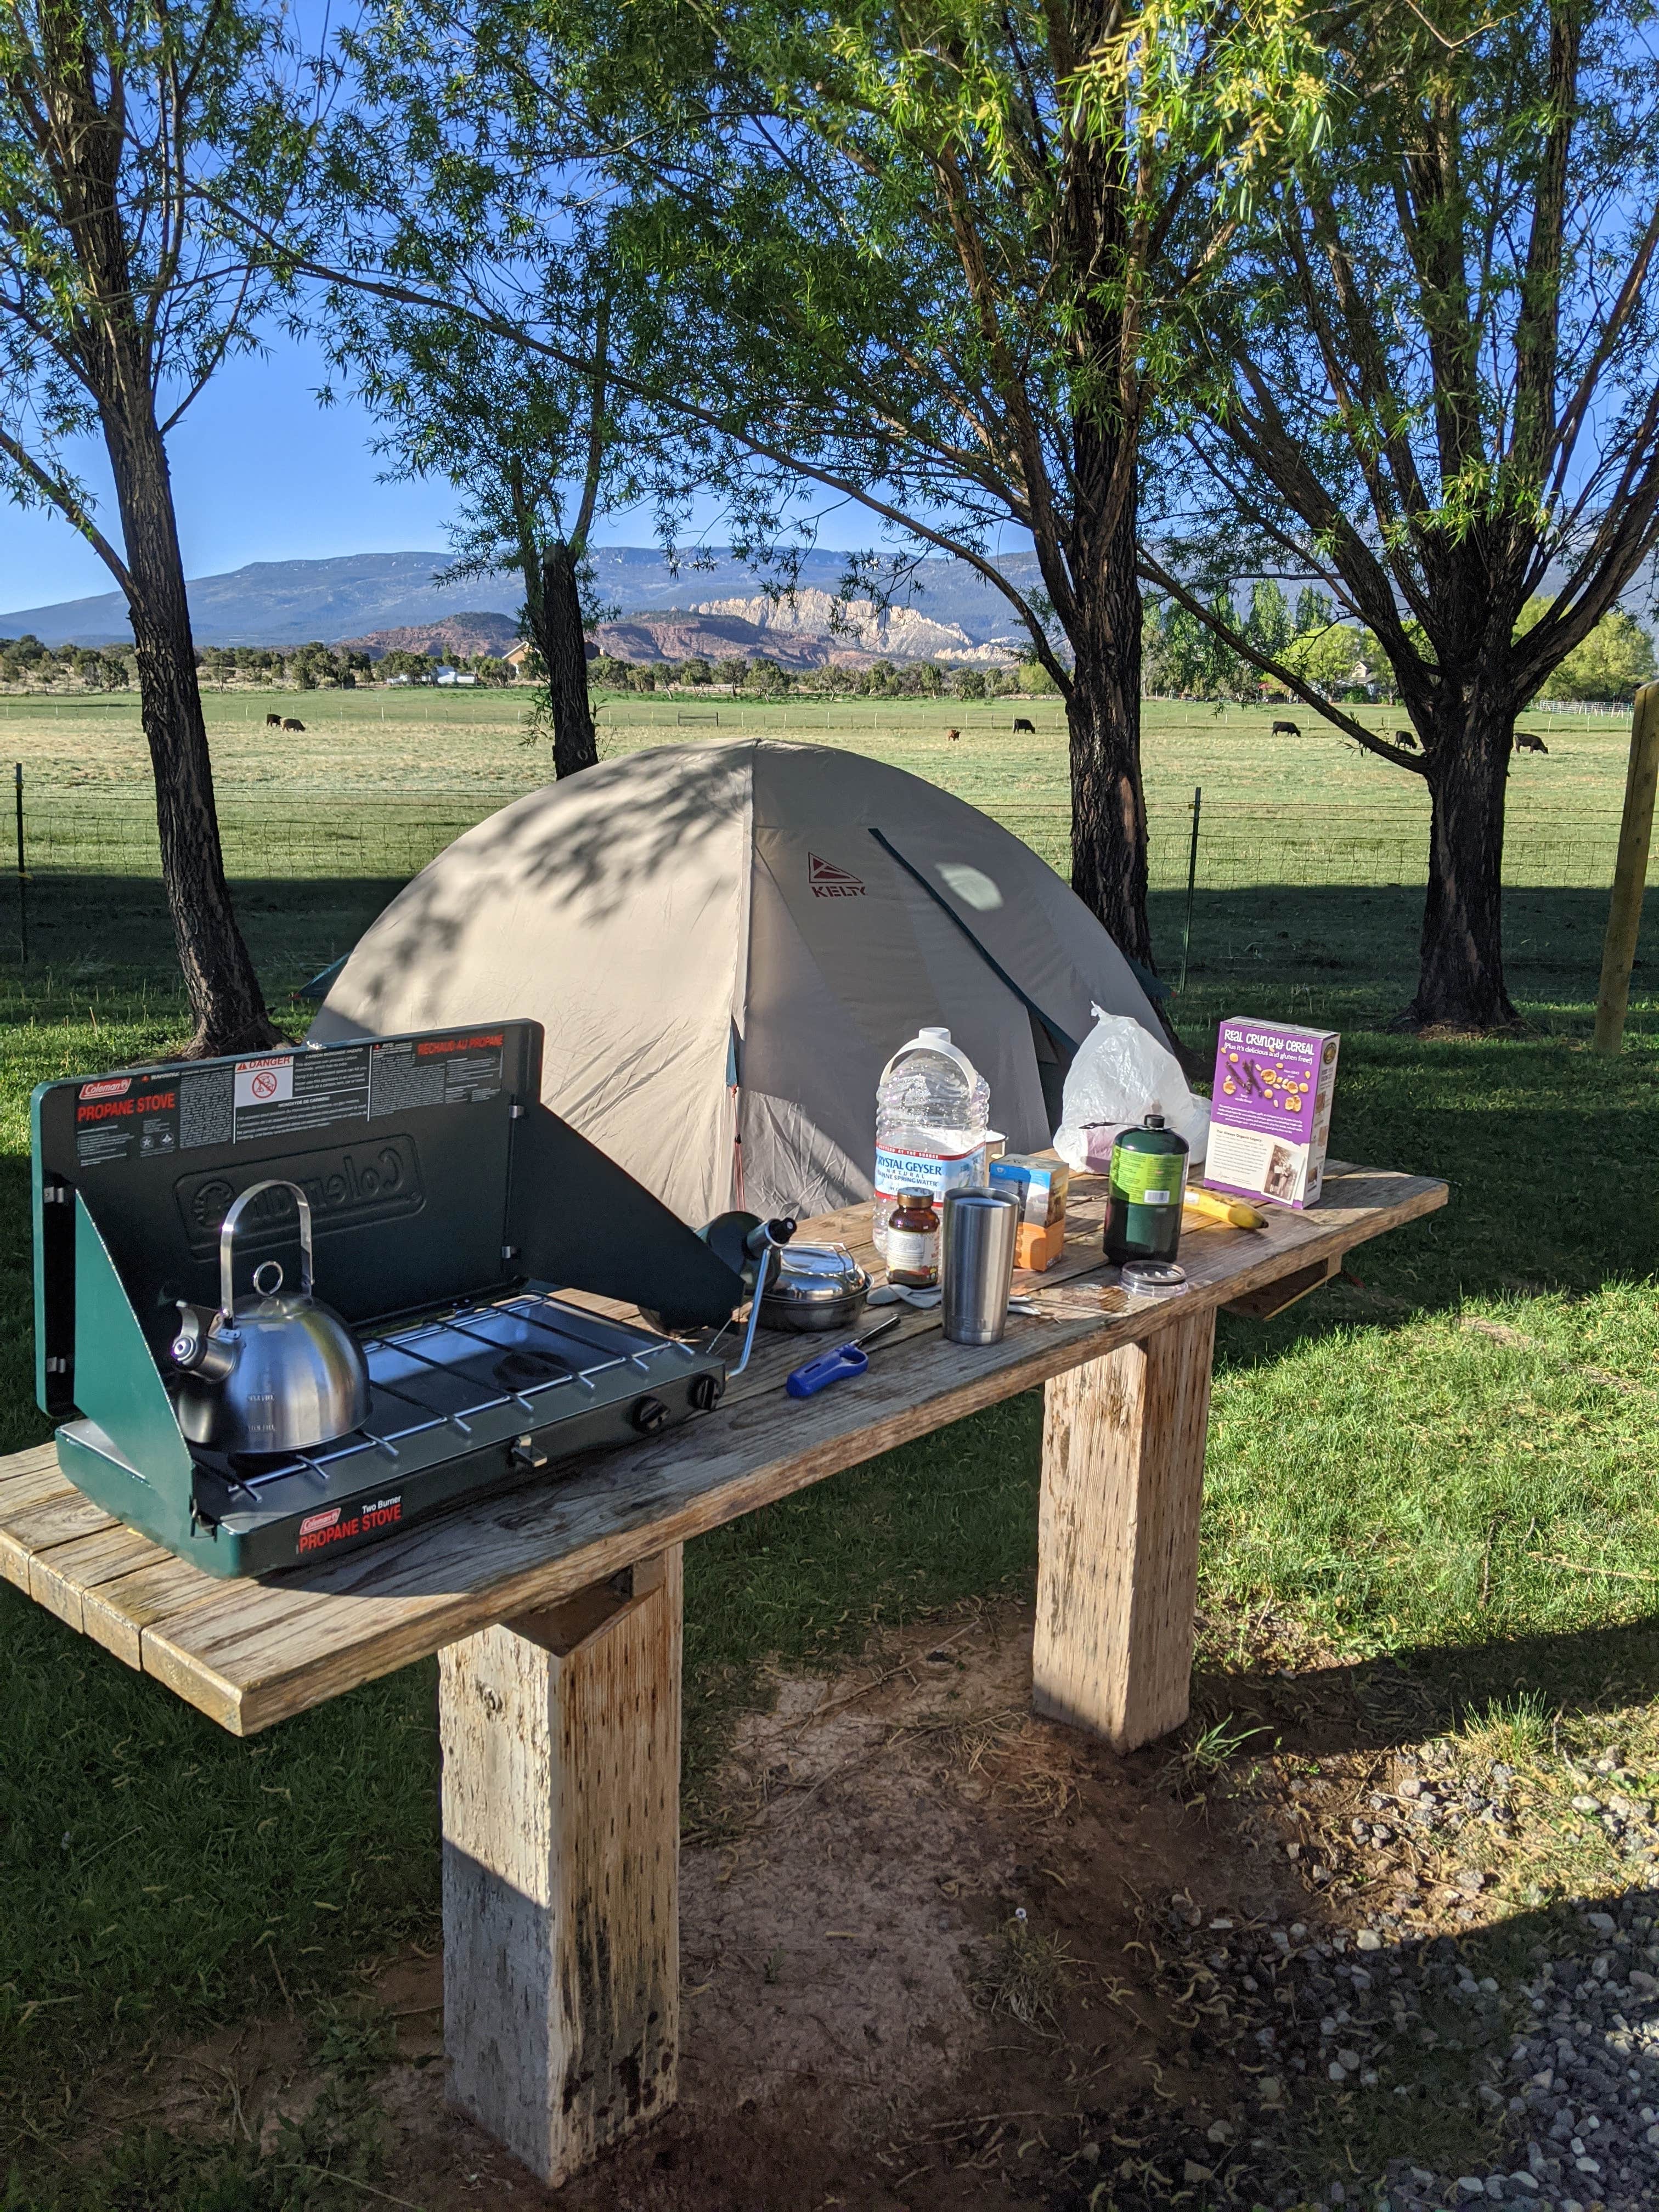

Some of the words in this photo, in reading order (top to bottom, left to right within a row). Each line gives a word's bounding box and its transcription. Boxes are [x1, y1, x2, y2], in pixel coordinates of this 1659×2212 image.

[811, 885, 868, 898] KELTY
[249, 1057, 290, 1069] DANGER
[1224, 1042, 1236, 1051] (Plus
[1245, 1046, 1268, 1056] delicious
[1298, 1056, 1313, 1065] free!)
[84, 1082, 121, 1095] Coleman
[77, 1099, 134, 1122] PROPANE
[137, 1092, 176, 1113] STOVE
[878, 1155, 904, 1170] RYSTAL
[905, 1161, 942, 1175] GEYSER
[887, 1169, 924, 1179] NATURAL
[362, 1505, 376, 1514] Two
[377, 1495, 402, 1508] Burner
[299, 1518, 359, 1554] PROPANE
[362, 1503, 402, 1532] STOVE
